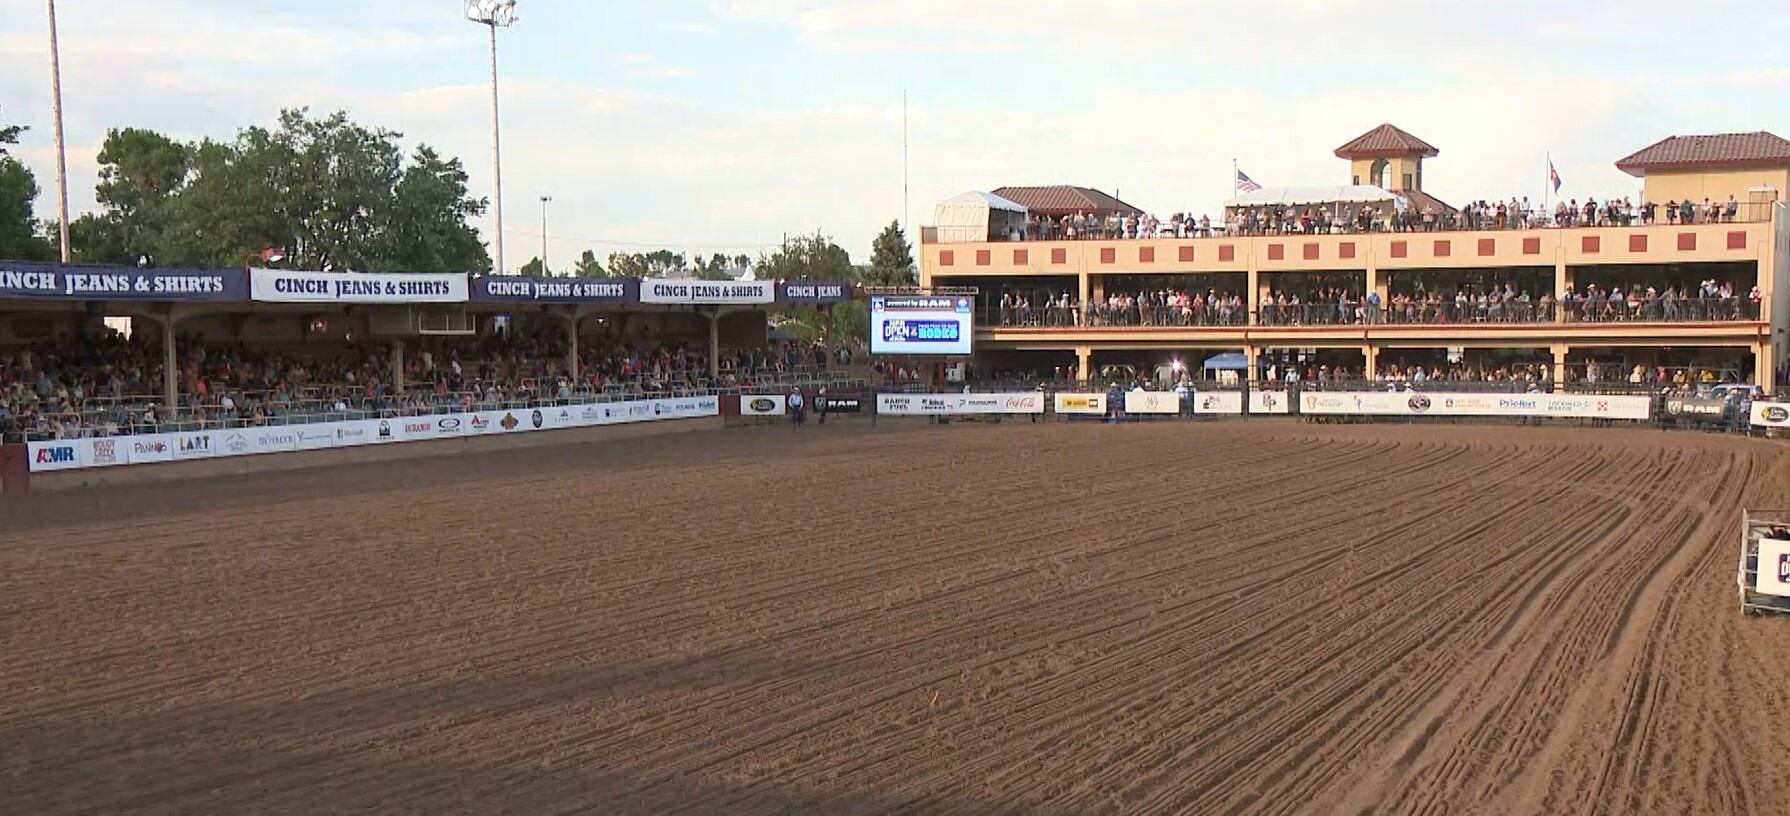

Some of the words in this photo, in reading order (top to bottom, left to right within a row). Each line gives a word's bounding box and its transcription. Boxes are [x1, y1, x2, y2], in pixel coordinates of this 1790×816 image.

[65, 274, 130, 295] JEANS
[134, 276, 150, 291] &
[154, 276, 223, 292] SHIRTS
[275, 278, 328, 293] CINCH
[335, 280, 381, 298] JEANS
[385, 281, 396, 295] &
[399, 280, 449, 295] SHIRTS
[488, 281, 530, 295] CINCH
[534, 283, 570, 299] JEANS
[573, 284, 582, 297] &
[584, 283, 624, 297] SHIRTS
[654, 284, 687, 297] CINCH
[691, 286, 721, 299] JEANS
[722, 287, 730, 297] &
[731, 286, 763, 297] SHIRTS
[787, 285, 815, 297] CINCH
[817, 285, 842, 298] JEANS
[919, 299, 951, 307] RAM
[885, 326, 909, 337] OPEN
[1682, 404, 1720, 414] RAM
[36, 446, 75, 463] AMR
